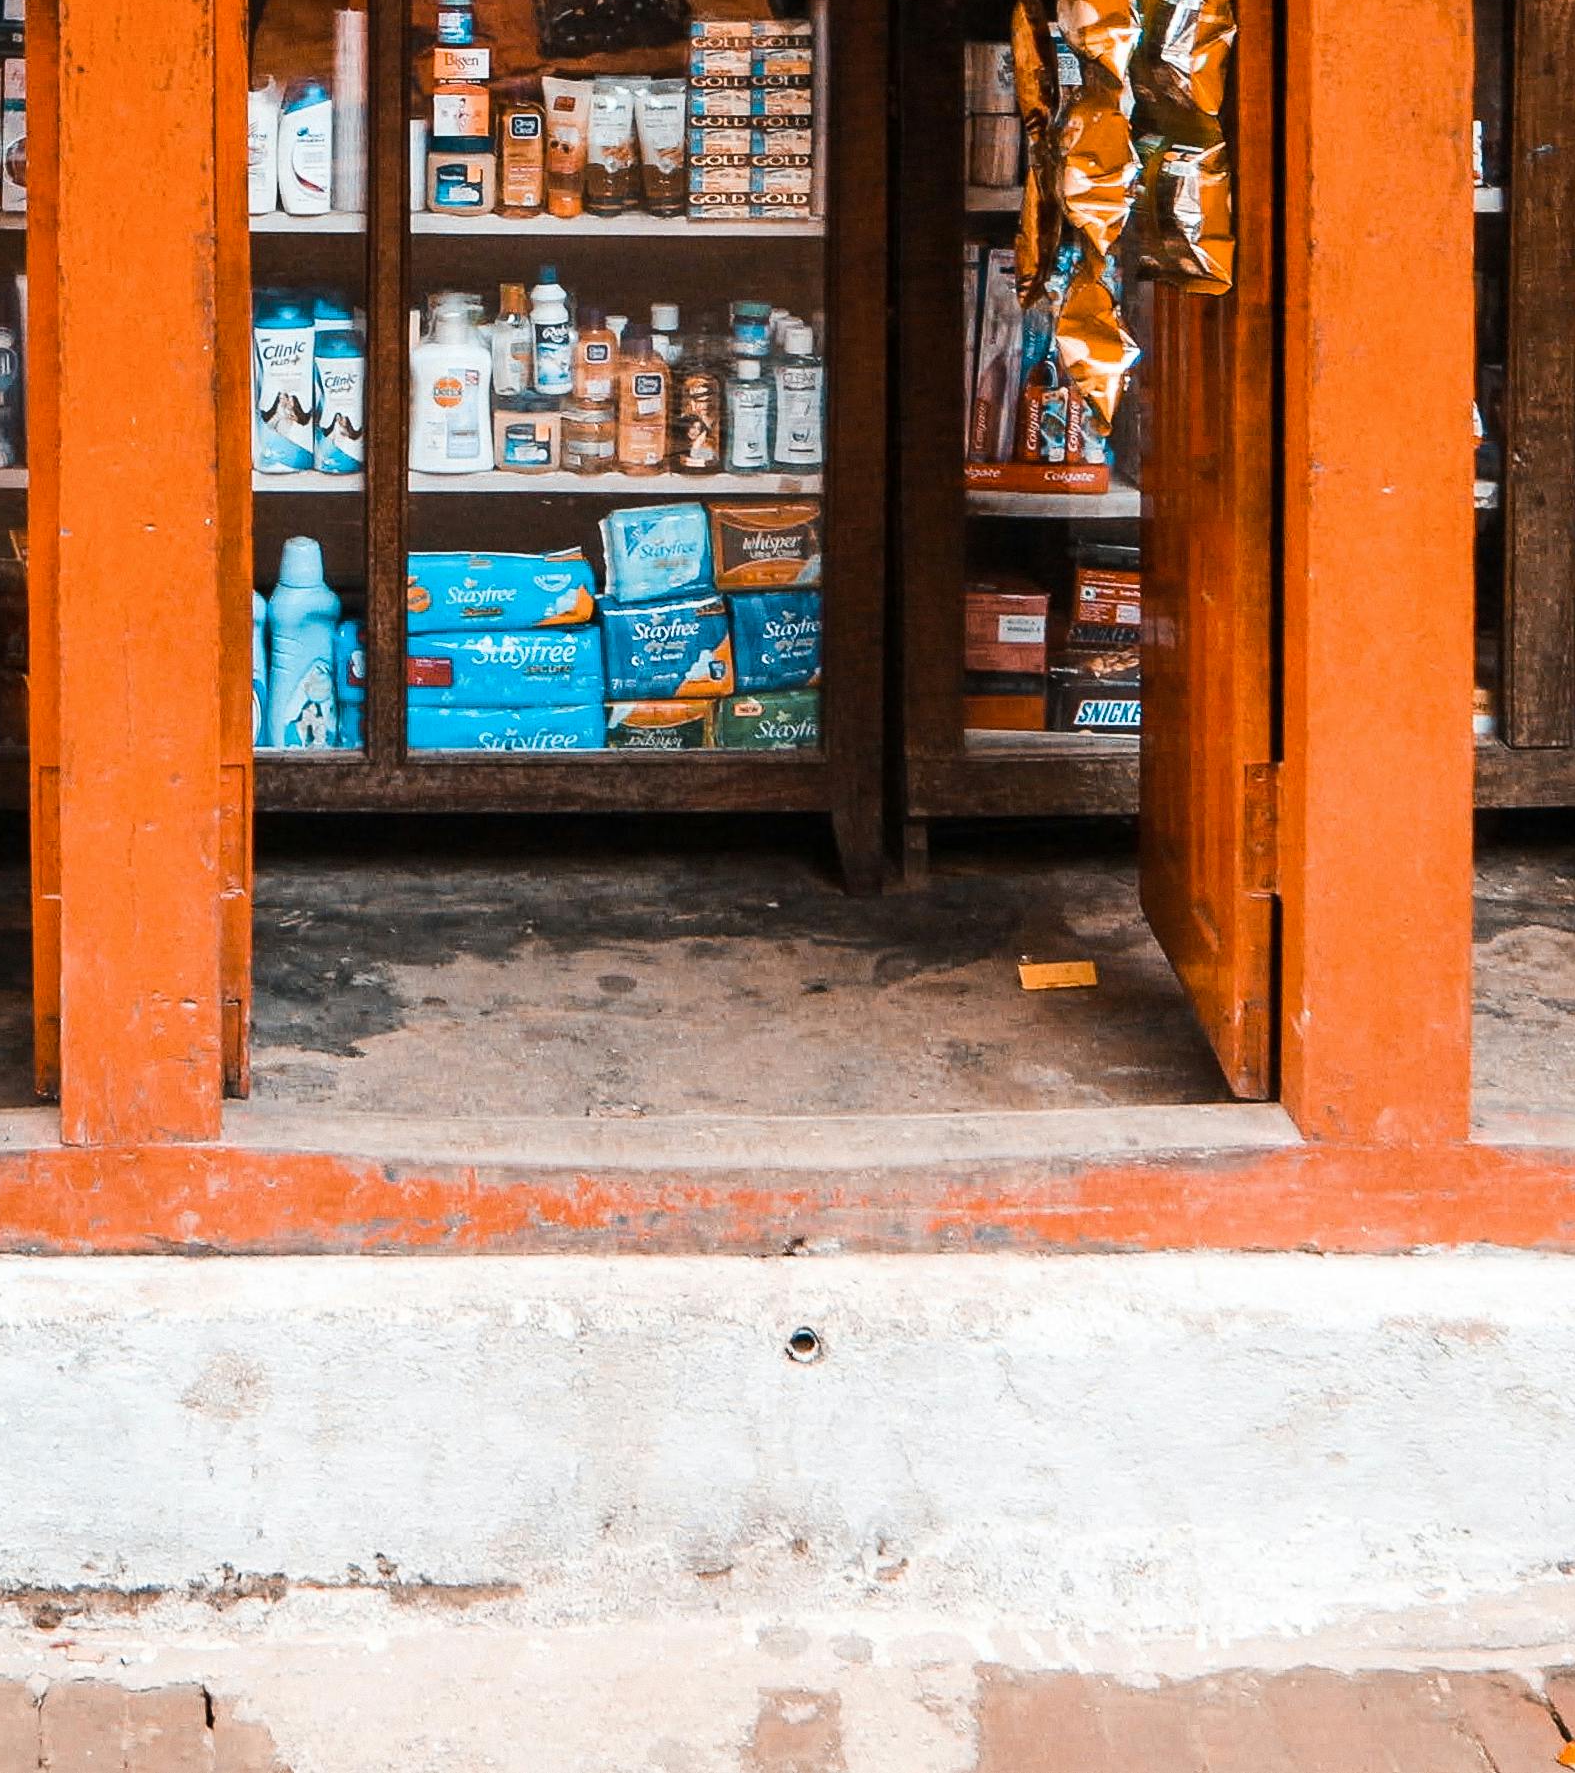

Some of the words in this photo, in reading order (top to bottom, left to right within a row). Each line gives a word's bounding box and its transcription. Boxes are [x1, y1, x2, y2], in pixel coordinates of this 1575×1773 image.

[690, 155, 746, 166] GOLD
[752, 155, 809, 166] GOLD
[689, 193, 746, 204] GOLD
[751, 193, 808, 204] GOLD
[263, 341, 306, 360] Clinic
[1026, 399, 1041, 451] Colgate
[1068, 400, 1081, 452] Colgate
[1044, 470, 1096, 484] Colgate
[446, 584, 518, 606] Stayfree
[632, 618, 700, 642] Stayfree
[472, 636, 577, 669] Stayfree
